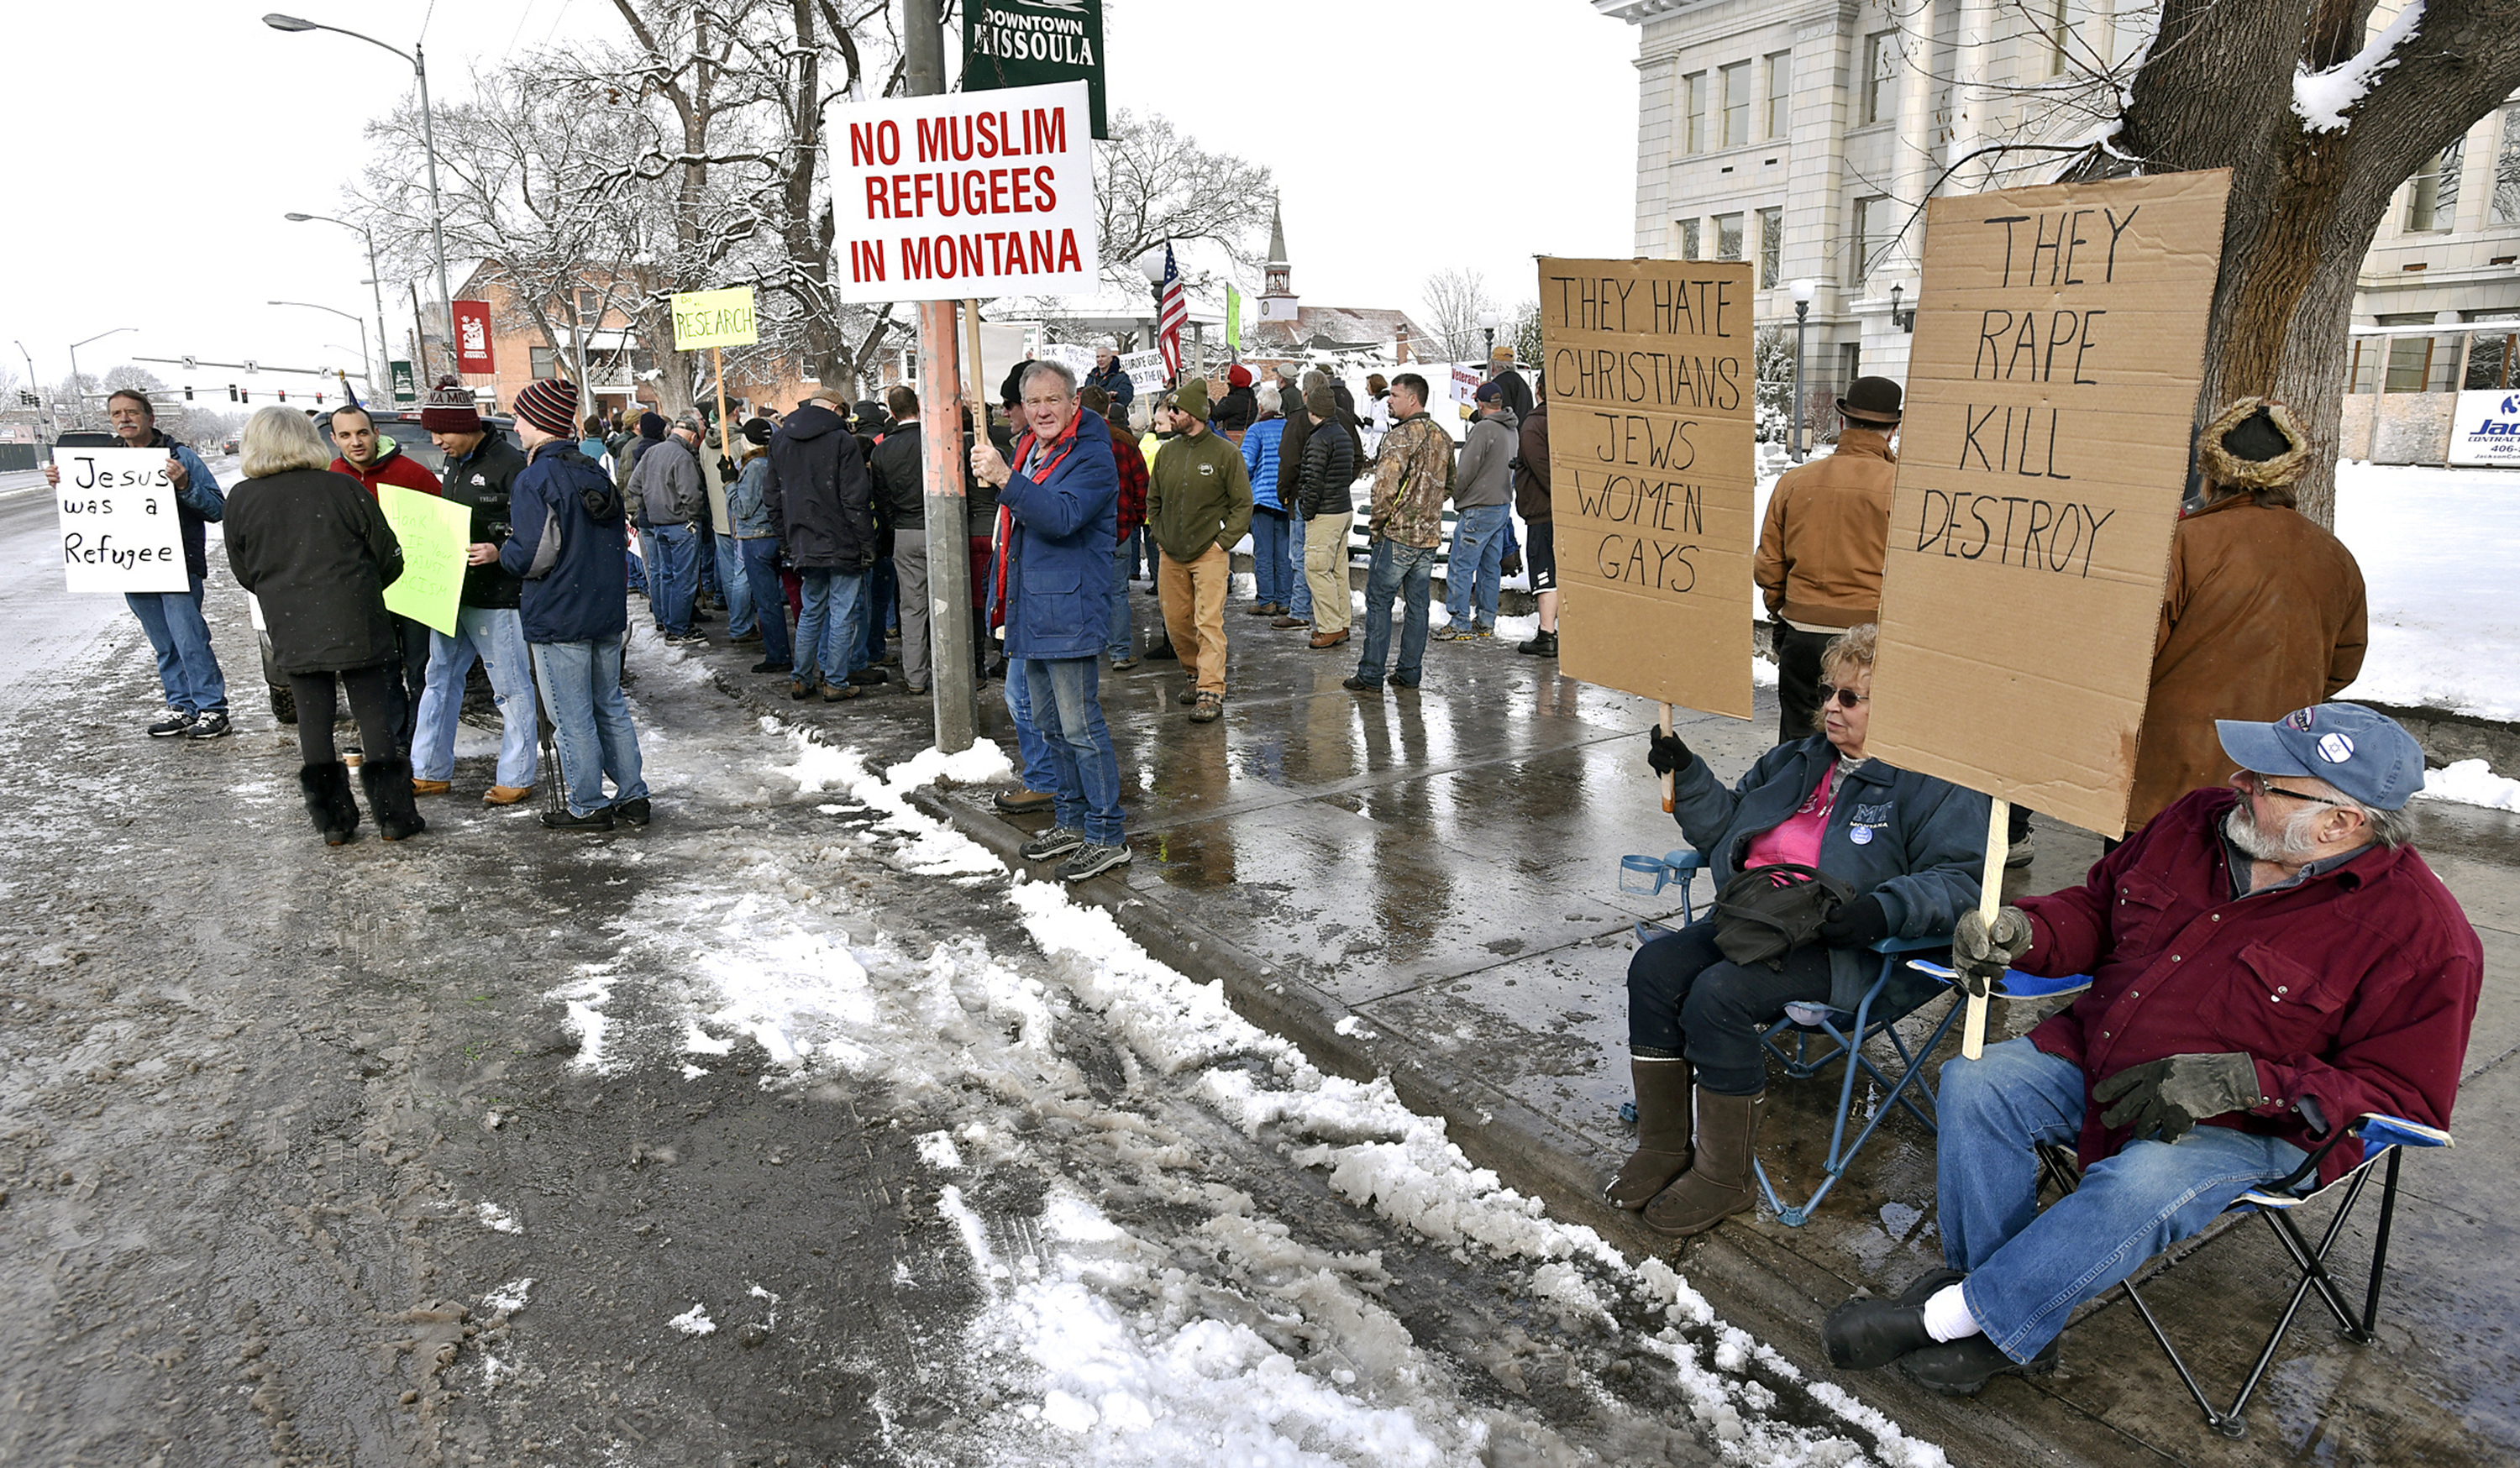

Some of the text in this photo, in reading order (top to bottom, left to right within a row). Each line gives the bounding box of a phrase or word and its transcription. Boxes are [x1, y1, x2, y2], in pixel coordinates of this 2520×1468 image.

[974, 24, 1095, 66] MISSOULA
[984, 8, 1083, 35] DOWNTOWN
[850, 107, 1067, 166] NO MUSLIM
[865, 165, 1057, 219] REFUGEES
[851, 228, 1082, 282] IN MONTANA
[1984, 205, 2139, 287] THEY
[675, 307, 753, 341] RESEARCH
[1551, 276, 1733, 338] THEY HATE
[1147, 353, 1163, 366] GOES
[1974, 309, 2107, 385] RAPE
[1452, 368, 1479, 386] Veterans
[1554, 349, 1740, 411] CHRISTIANS
[1594, 413, 1698, 470] JEWS
[1959, 403, 2071, 480] KILL
[74, 457, 169, 489] Jesus
[64, 498, 157, 515] was a
[1575, 470, 1702, 534] WOMEN
[65, 532, 172, 570] Refugee
[1917, 489, 2115, 579] DESTROY
[405, 554, 445, 574] GAINST
[1598, 533, 1699, 593] GAYS
[1853, 800, 1893, 823] MT
